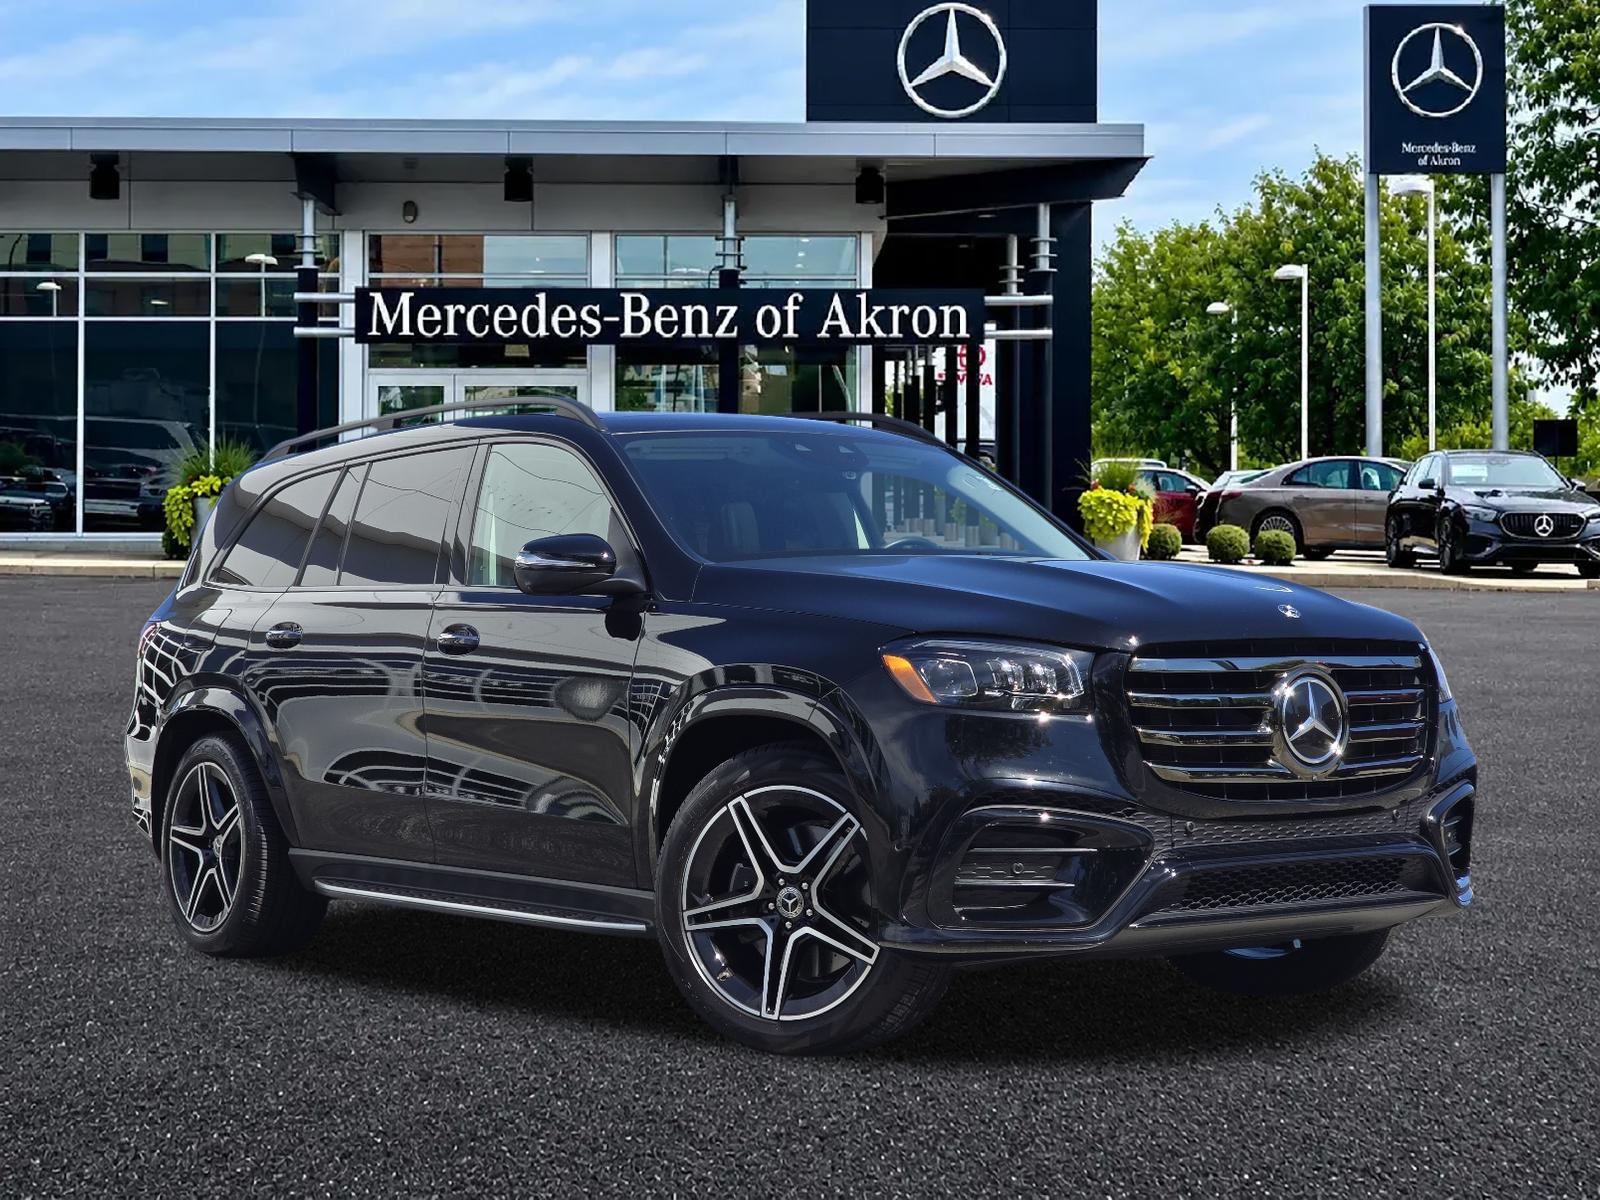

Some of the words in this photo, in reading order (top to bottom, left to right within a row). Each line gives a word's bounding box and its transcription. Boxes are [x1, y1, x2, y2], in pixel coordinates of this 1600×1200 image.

[1401, 141, 1476, 153] Mercedes-Benz
[1418, 154, 1428, 165] of
[1430, 154, 1460, 165] Akron
[367, 292, 738, 338] Mercedes-Benz
[755, 292, 804, 338] of
[816, 292, 970, 338] Akron
